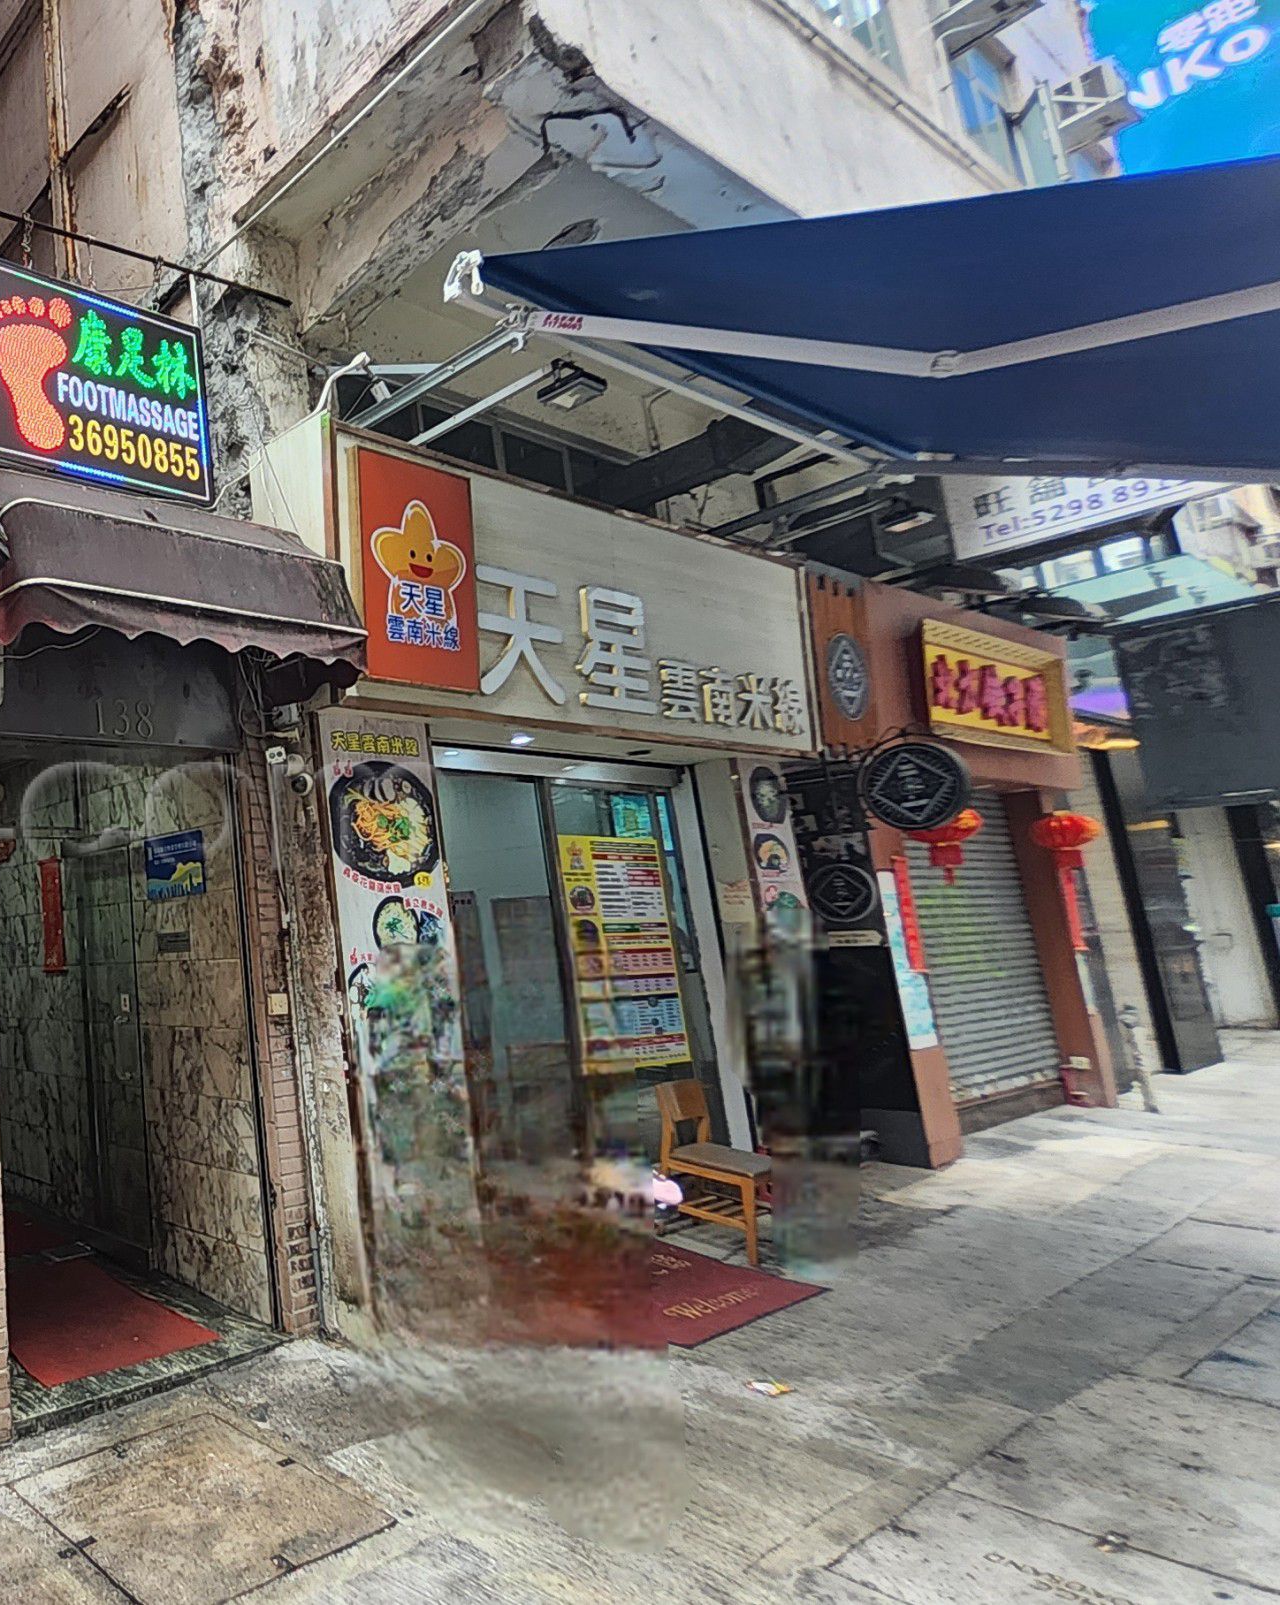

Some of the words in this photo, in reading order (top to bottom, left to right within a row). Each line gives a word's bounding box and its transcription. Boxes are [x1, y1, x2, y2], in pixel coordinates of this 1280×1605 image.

[72, 308, 197, 400] 康足林
[68, 414, 200, 482] 36950855
[401, 581, 446, 618] 天星
[387, 614, 460, 651] 雲南米線
[475, 564, 658, 716] 天星
[95, 696, 155, 740] 138
